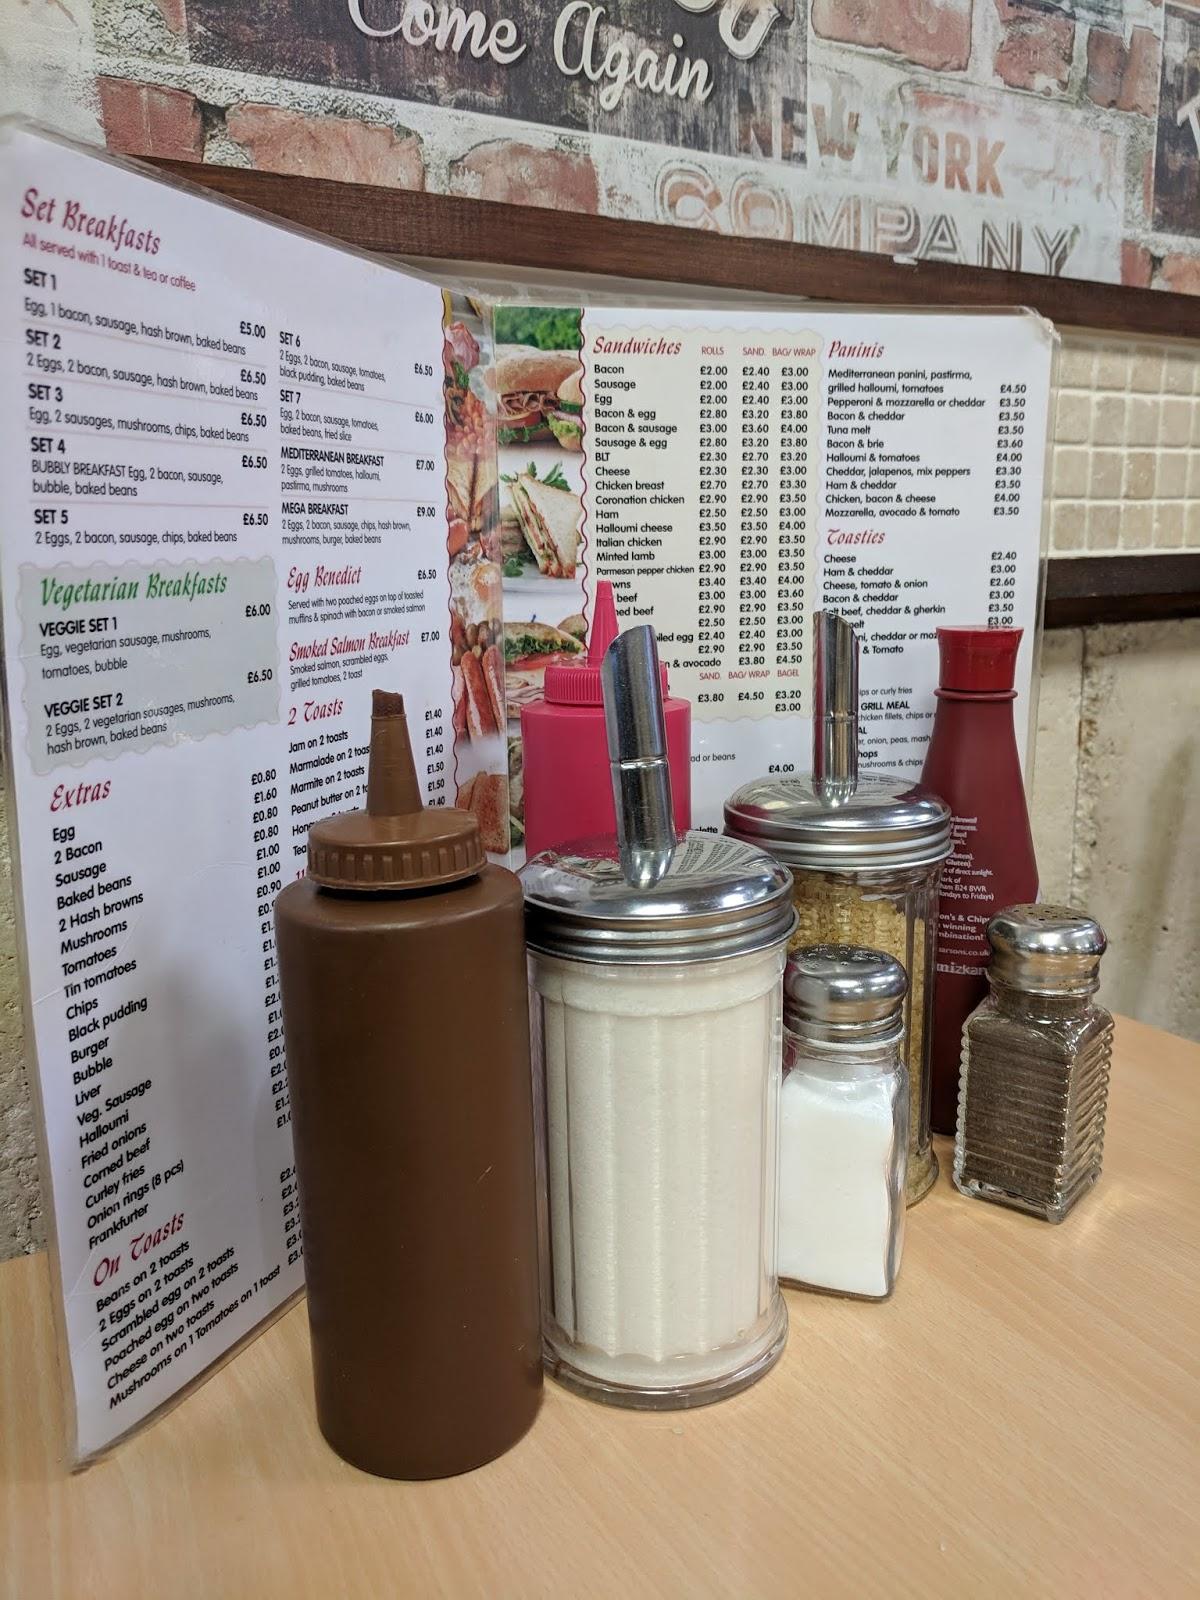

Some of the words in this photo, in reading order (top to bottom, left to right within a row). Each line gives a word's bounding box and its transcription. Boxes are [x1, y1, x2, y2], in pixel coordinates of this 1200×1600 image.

[348, 0, 527, 64] Come
[553, 1, 713, 111] Again
[878, 119, 1006, 198] YORK
[21, 188, 56, 223] Set
[62, 200, 161, 255] Breakfasts
[22, 232, 37, 249] All
[40, 239, 75, 259] served
[77, 250, 99, 265] with
[101, 254, 105, 267] 1
[107, 256, 132, 274] toast
[133, 263, 141, 276] &
[142, 266, 158, 282] tea
[159, 273, 169, 284] or
[170, 275, 196, 292] coffee
[24, 268, 48, 288] SET
[51, 274, 57, 290] 1
[240, 320, 266, 339] £5.00
[25, 328, 49, 347] SET
[52, 333, 61, 350] 2
[279, 331, 294, 346] SET
[295, 335, 301, 348] 6
[592, 336, 682, 355] Sandwiches
[701, 346, 724, 356] ROLLS
[772, 347, 792, 357] BAG/
[793, 348, 816, 357] WRAP
[828, 340, 884, 359] Paninis
[240, 368, 266, 386] £6.50
[414, 362, 433, 377] £6.50
[594, 364, 624, 374] Bacon
[700, 365, 728, 376] £2.00
[742, 366, 770, 376] £2.40
[781, 367, 809, 377] £3.00
[28, 383, 51, 400] SET
[55, 386, 63, 402] 3
[594, 378, 636, 392] Sausage
[700, 380, 728, 390] £2.00
[742, 380, 770, 391] £2.40
[781, 381, 808, 391] £3.00
[280, 389, 294, 403] SET
[296, 392, 301, 404] 7
[594, 393, 612, 406] Egg
[700, 394, 728, 404] £2.00
[742, 395, 770, 405] £2.40
[781, 395, 808, 405] £3.00
[240, 412, 267, 428] £6.50
[414, 411, 434, 424] £6.00
[827, 425, 849, 434] Tuna
[850, 424, 871, 435] melt
[998, 425, 1024, 435] £3.50
[30, 436, 54, 453] SET
[57, 439, 66, 454] 4
[826, 439, 855, 448] Bacon
[857, 439, 864, 448] &
[867, 438, 884, 448] brie
[997, 439, 1024, 448] £3.60
[242, 455, 268, 469] £6.50
[280, 446, 345, 463] MEDITERRANEAN
[346, 452, 384, 467] BREAKFAST
[416, 459, 435, 471] £7.00
[595, 452, 610, 462] BLT
[699, 452, 727, 462] £2.30
[742, 452, 769, 462] £2.70
[780, 452, 808, 462] £3.20
[595, 466, 630, 476] Cheese
[699, 466, 727, 476] £2.30
[741, 466, 769, 476] £2.30
[780, 466, 807, 476] £3.00
[595, 495, 647, 505] Coronation
[649, 494, 685, 504] chicken
[699, 494, 727, 504] £2.90
[741, 494, 768, 503] £2.90
[779, 493, 806, 503] £3.50
[34, 508, 57, 524] SET
[60, 509, 68, 524] 5
[282, 502, 306, 514] MEGA
[308, 502, 349, 515] BREAKFAST
[416, 506, 436, 517] £9.00
[596, 510, 619, 519] Ham
[699, 508, 727, 518] £2.50
[740, 507, 768, 517] £2.50
[779, 507, 806, 517] £3.00
[242, 513, 268, 526] £6.50
[596, 523, 638, 533] Halloumi
[640, 522, 673, 533] cheese
[699, 522, 726, 532] £3.50
[740, 521, 768, 531] £3.50
[778, 520, 806, 530] £4.00
[34, 531, 42, 544] 2
[44, 531, 72, 548] Eggs,
[74, 531, 82, 544] 2
[84, 530, 117, 545] bacon,
[119, 534, 160, 546] sausage,
[161, 530, 186, 545] chips,
[187, 530, 212, 543] baked
[214, 530, 238, 542] beans
[827, 529, 886, 546] Toasties
[824, 554, 856, 564] Cheese
[991, 551, 1017, 561] £2.40
[287, 566, 310, 594] Egg
[314, 565, 362, 587] Benedict
[417, 569, 437, 580] £6.50
[41, 576, 140, 612] Vegetarian
[146, 571, 228, 602] Breakfasts
[823, 580, 858, 590] Cheese,
[860, 580, 892, 589] tomato
[894, 579, 902, 589] &
[903, 579, 928, 588] onion
[990, 577, 1016, 587] £2.60
[245, 603, 271, 618] £6.00
[39, 619, 86, 637] VEGGIE
[88, 617, 109, 633] SET
[112, 616, 117, 630] 1
[421, 630, 440, 643] £7.00
[289, 638, 329, 662] Smoked
[330, 635, 366, 656] Salmon
[368, 630, 410, 652] Breakfast
[247, 668, 273, 684] £6.50
[728, 670, 747, 680] BAG/
[748, 670, 770, 679] WRAP
[777, 668, 800, 678] BAGEL
[44, 698, 90, 718] VEGGIE
[92, 694, 113, 710] SET
[116, 692, 124, 706] 2
[288, 707, 297, 726] 2
[304, 698, 344, 722] Toasts
[860, 702, 884, 711] GRILL
[886, 700, 910, 710] MEAL
[251, 768, 276, 786] £0.80
[768, 764, 794, 774] £4.00
[50, 780, 111, 812] Extras
[52, 826, 75, 844] Egg
[54, 850, 62, 865] 2
[65, 841, 102, 861] Bacon
[55, 862, 107, 887] Sausage
[57, 884, 95, 910] Baked
[97, 876, 132, 896] beans
[943, 923, 976, 933] winning
[61, 920, 128, 954] Mushrooms
[61, 946, 117, 976] Tomatoes
[66, 998, 98, 1020] Chips
[70, 1036, 110, 1064] Burger
[75, 1084, 102, 1106] Liver
[93, 1255, 121, 1286] On
[129, 1213, 185, 1261] Toasts
